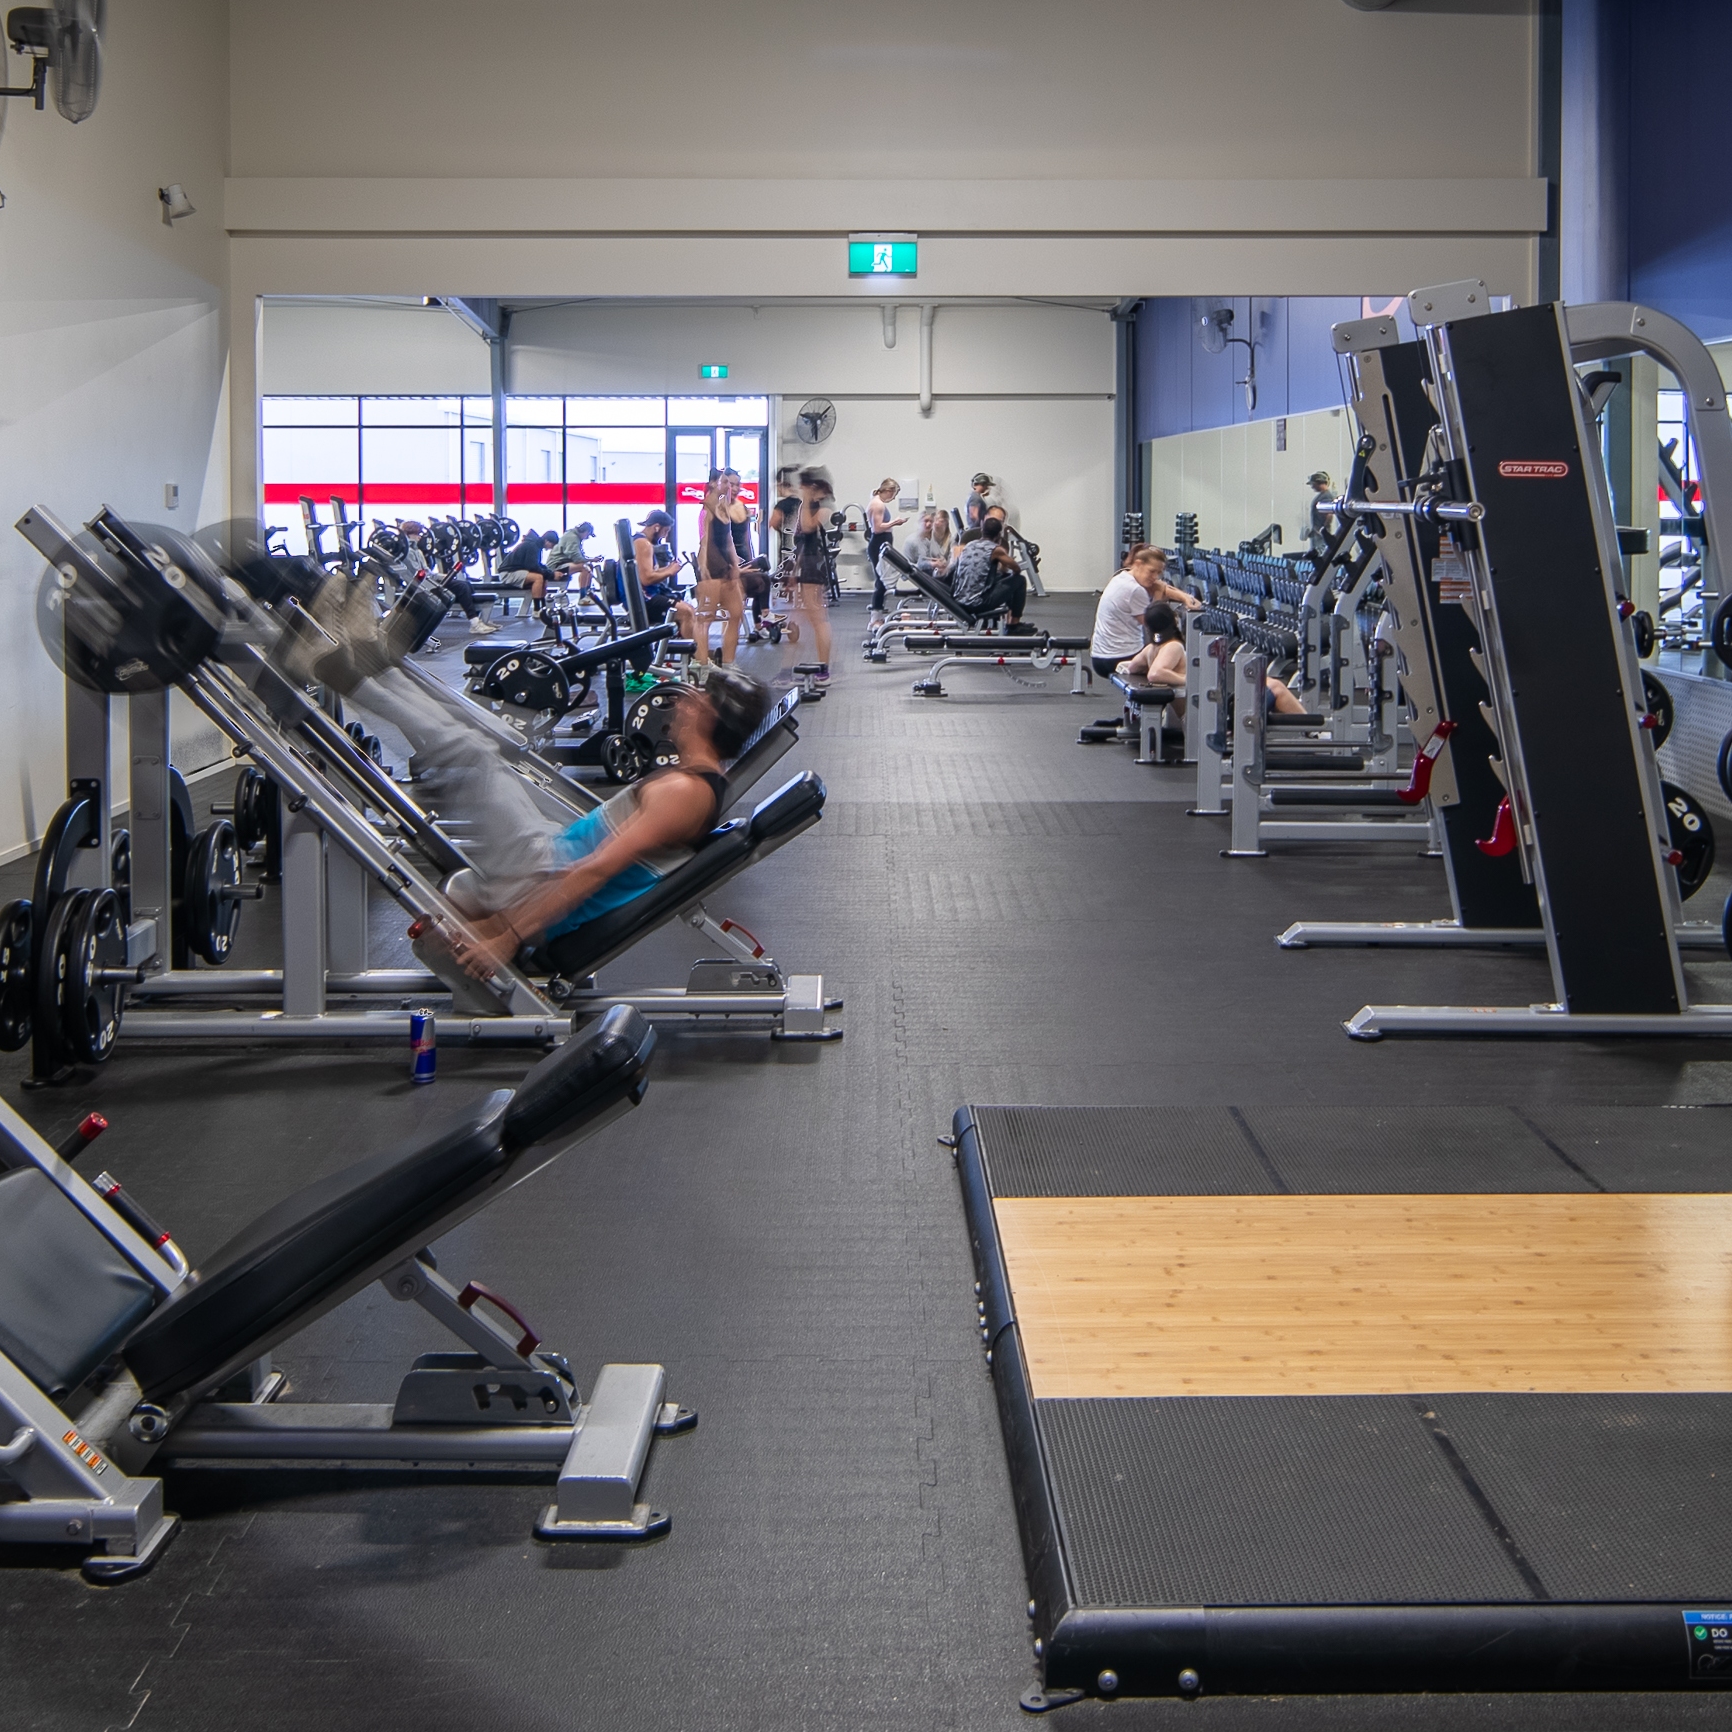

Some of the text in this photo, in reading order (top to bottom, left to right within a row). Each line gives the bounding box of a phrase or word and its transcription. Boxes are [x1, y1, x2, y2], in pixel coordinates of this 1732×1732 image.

[1501, 465, 1563, 473] STAR TRAC
[496, 659, 520, 681] 20
[631, 704, 649, 730] 20
[1668, 797, 1701, 832] 20
[99, 1020, 115, 1050] 20
[1711, 1628, 1728, 1638] DO
